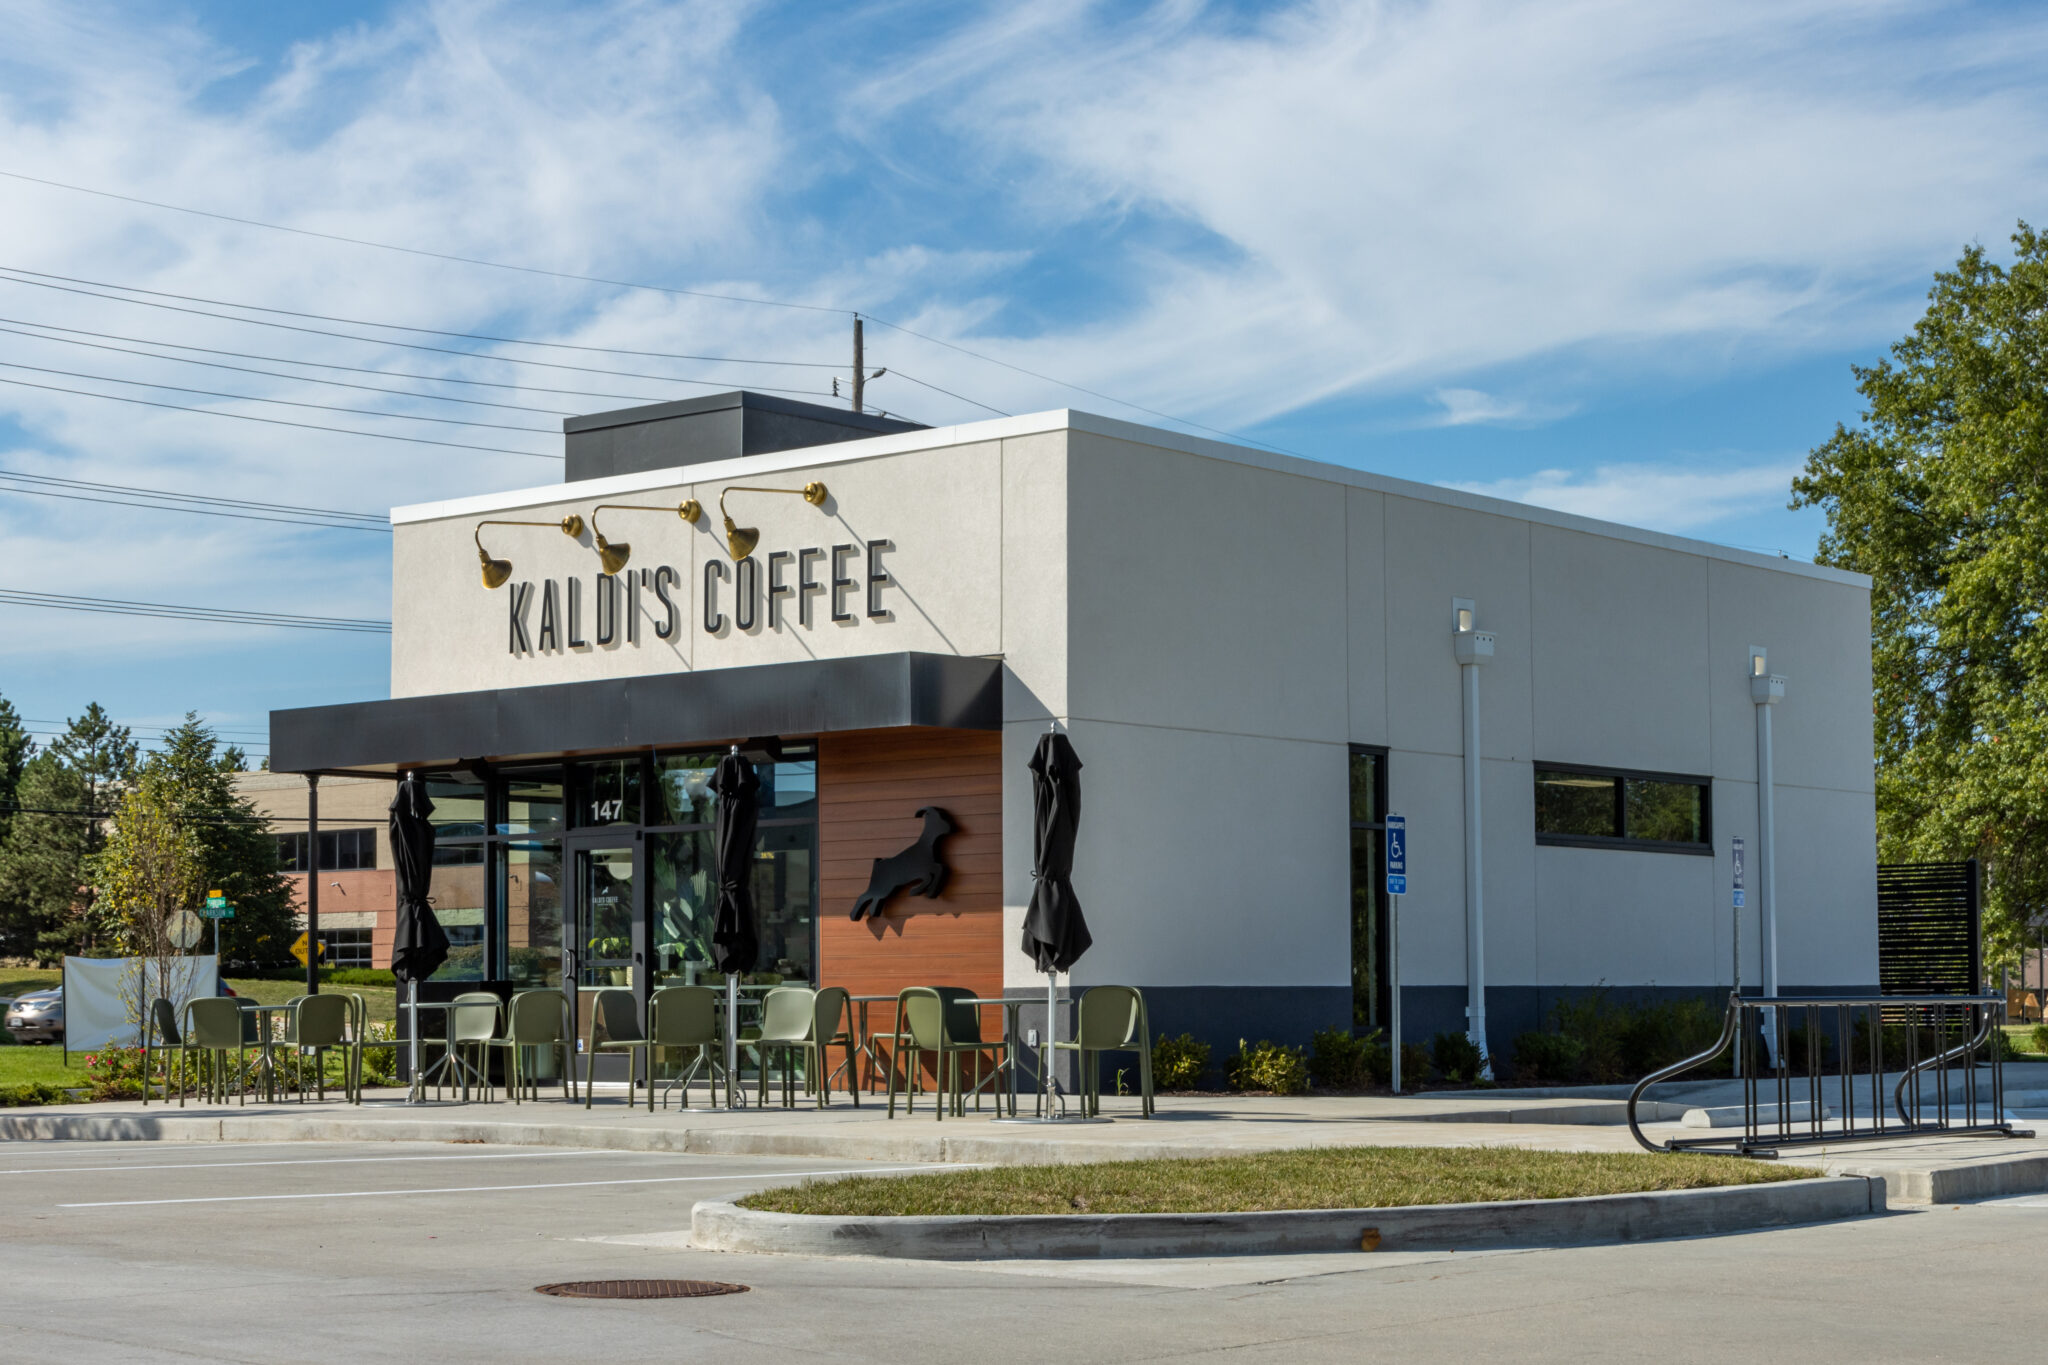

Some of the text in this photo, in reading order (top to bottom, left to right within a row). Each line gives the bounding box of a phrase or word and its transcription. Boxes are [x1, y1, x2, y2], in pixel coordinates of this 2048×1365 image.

[509, 539, 892, 654] KALDI'S COFFEE
[591, 800, 622, 820] 147
